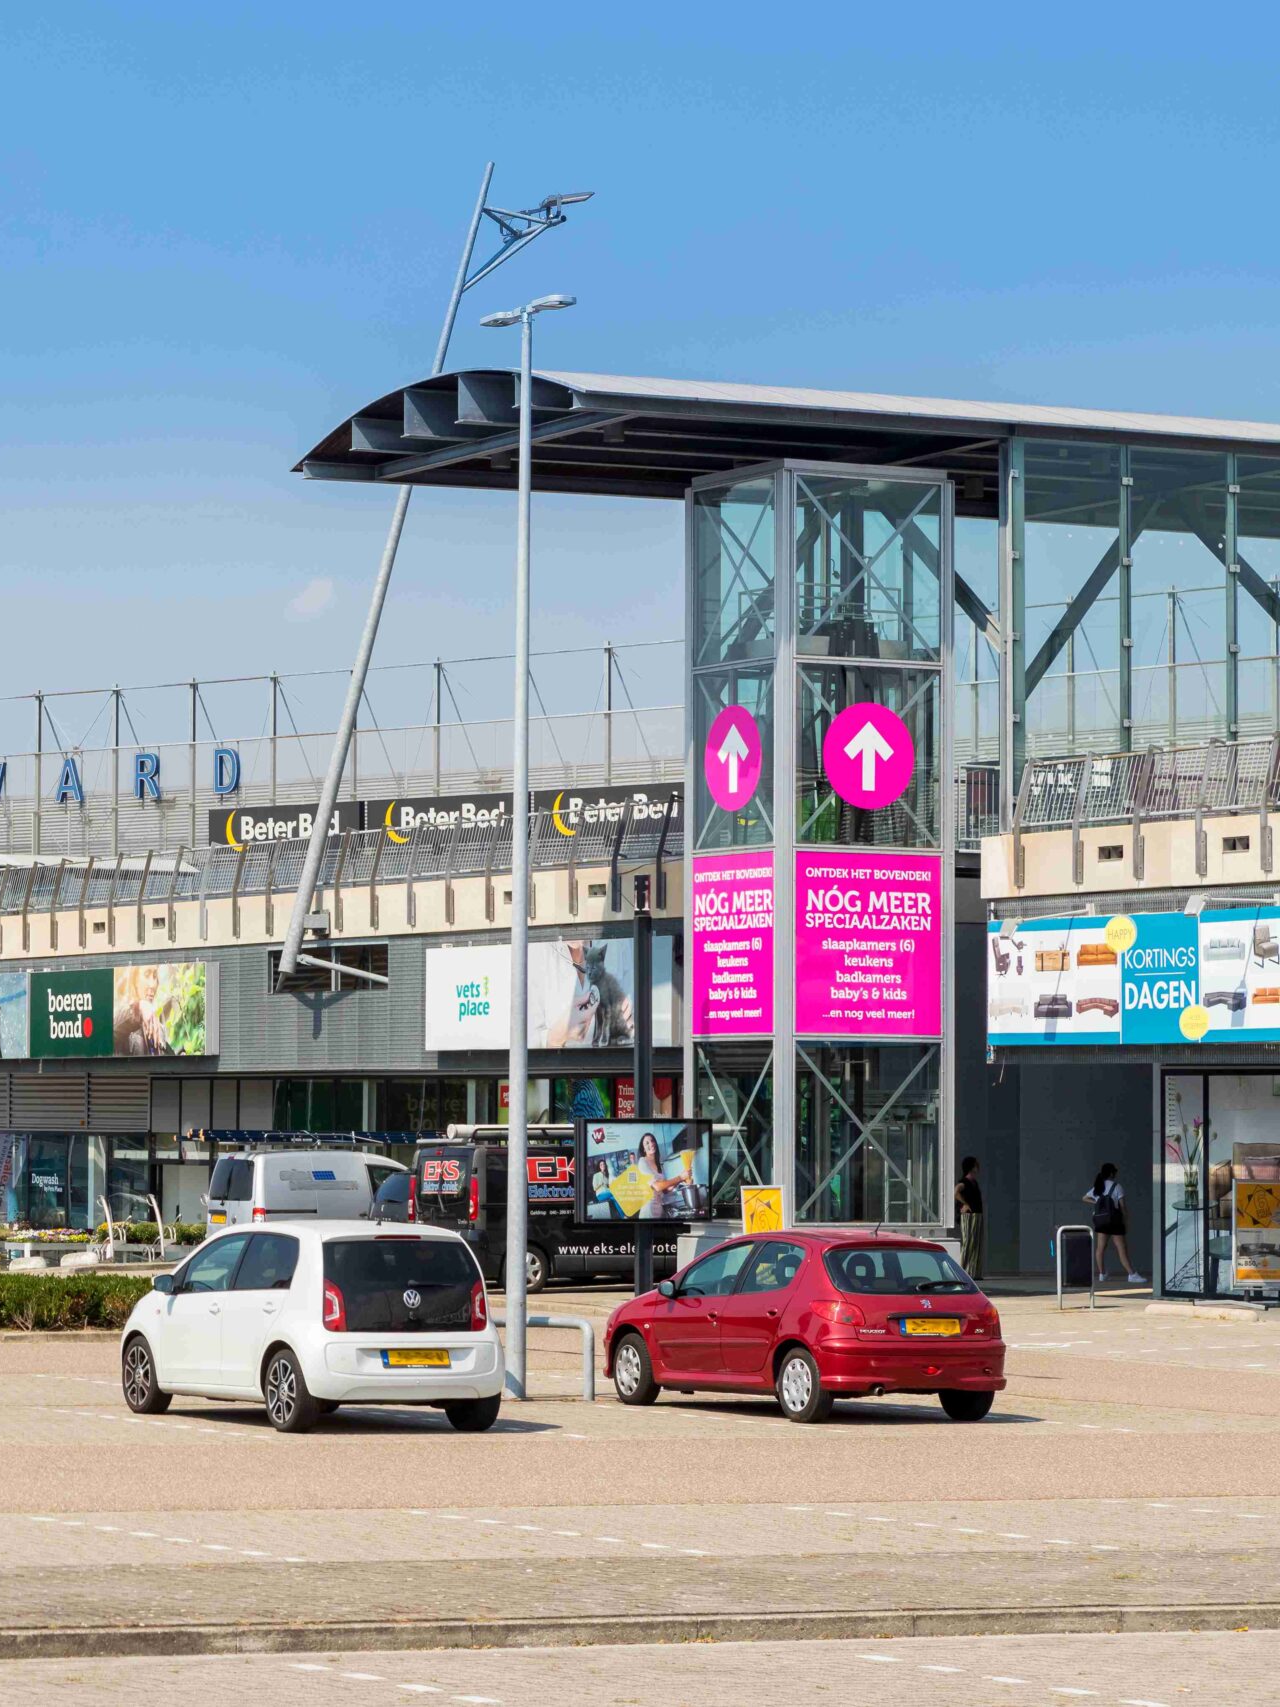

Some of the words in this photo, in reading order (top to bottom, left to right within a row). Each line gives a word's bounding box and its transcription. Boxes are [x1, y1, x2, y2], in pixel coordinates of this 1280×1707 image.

[299, 810, 339, 838] Bd
[695, 870, 720, 883] ONTDEK
[721, 869, 734, 881] HET
[736, 867, 773, 880] BOVENDEK!
[806, 867, 849, 879] ONTDEK
[851, 868, 871, 880] HET
[874, 869, 931, 881] BOVENDEK!
[695, 888, 728, 915] NÓG
[732, 889, 773, 913] MEER
[806, 885, 861, 912] NÓG
[868, 892, 931, 914] MEER
[694, 913, 773, 932] SPECIAALZAKEN
[806, 913, 931, 931] SPECIAALZAKEN
[1107, 929, 1133, 940] HAPPY
[704, 939, 750, 954] slaapkamers
[751, 937, 762, 951] (6)
[822, 937, 896, 953] slaapkamers
[899, 939, 915, 952] (6)
[717, 955, 748, 967] keukens
[844, 954, 894, 967] keukens
[1125, 947, 1196, 969] KORTINGS
[712, 971, 754, 984] badkamers
[836, 970, 902, 983] badkamers
[456, 981, 480, 998] vets
[741, 986, 757, 998] kids
[830, 986, 868, 1002] baby's
[871, 988, 880, 999] &
[883, 987, 907, 1000] kids
[1125, 980, 1195, 1010] DAGEN
[47, 988, 92, 1012] boeren
[459, 999, 490, 1022] place
[717, 1010, 730, 1020] nog
[731, 1008, 743, 1018] veel
[744, 1007, 762, 1018] meer!
[844, 1010, 864, 1020] nog
[866, 1008, 885, 1018] veel
[887, 1008, 915, 1019] meer!
[49, 1013, 83, 1039] bond
[424, 1160, 460, 1180] EKS
[32, 1173, 58, 1187] Dogwash
